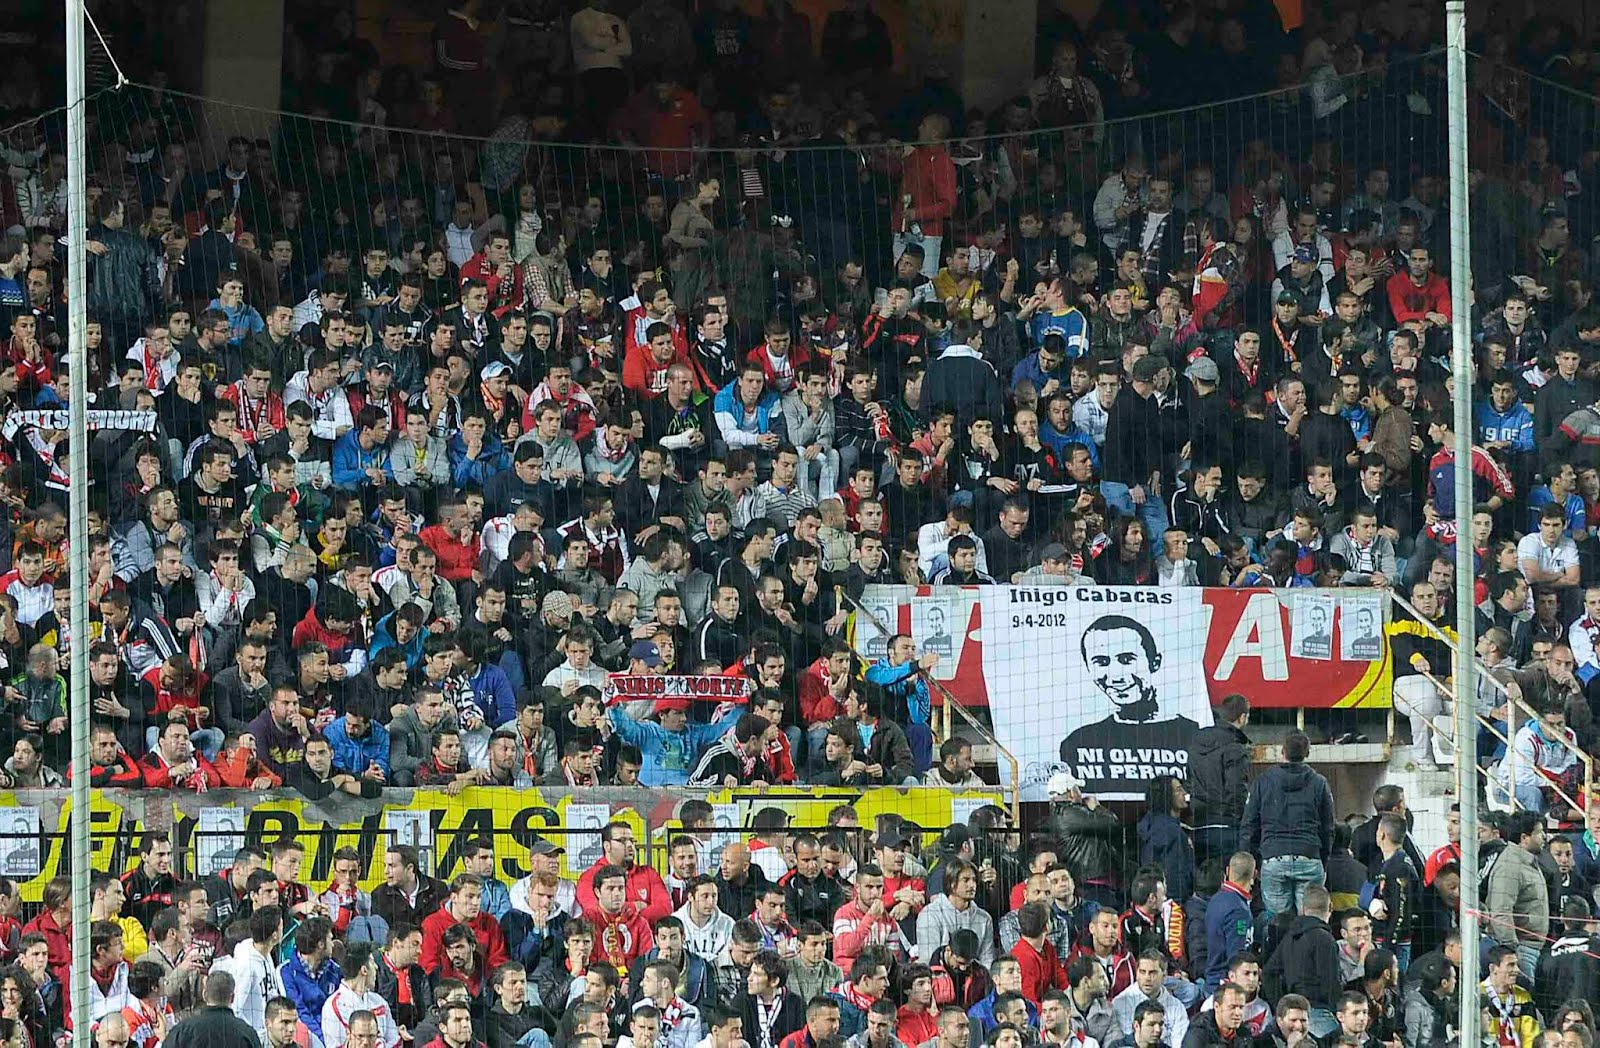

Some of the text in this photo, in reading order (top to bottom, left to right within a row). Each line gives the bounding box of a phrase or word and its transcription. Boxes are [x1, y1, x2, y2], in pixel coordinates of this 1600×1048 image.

[1010, 588, 1173, 605] Iñigo Cabacas
[1012, 613, 1066, 628] 9-4-2012
[1076, 748, 1189, 764] NI OLVIDO
[1076, 765, 1105, 780] NI
